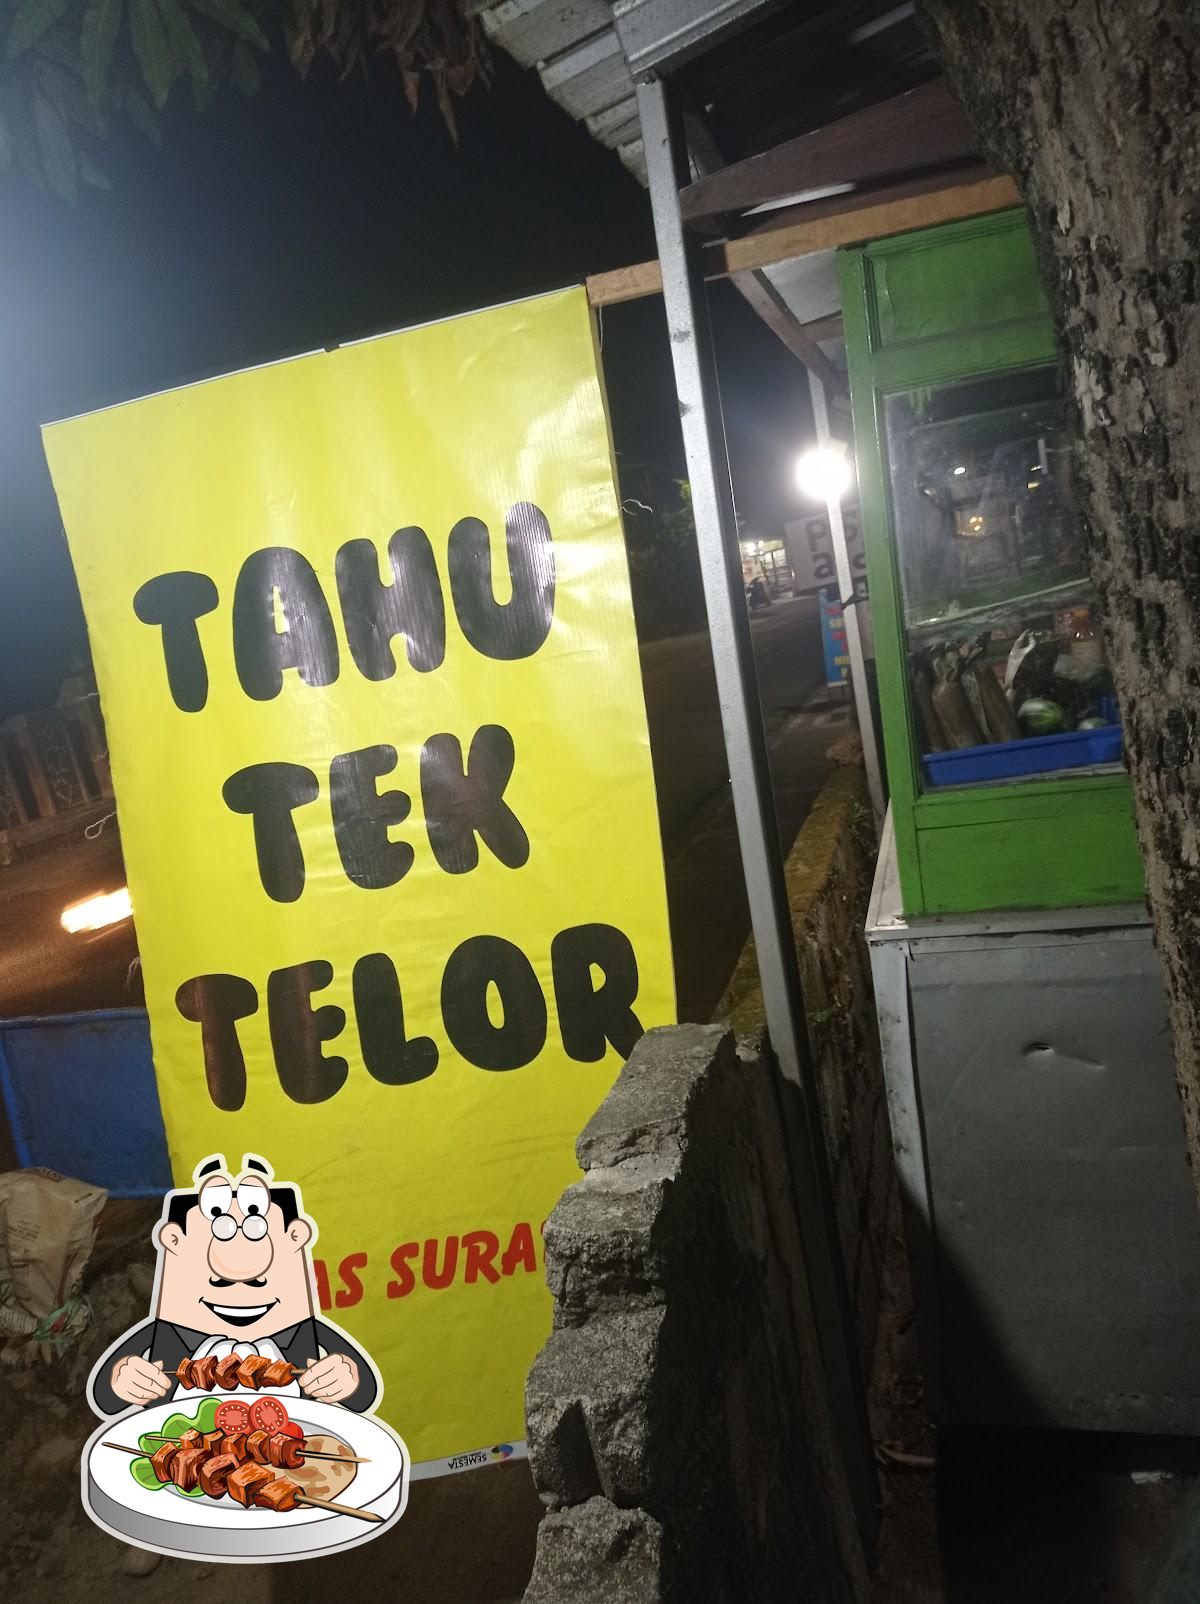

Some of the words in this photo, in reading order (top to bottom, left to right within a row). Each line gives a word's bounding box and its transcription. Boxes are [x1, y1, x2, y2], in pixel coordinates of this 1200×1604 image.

[134, 501, 556, 712] TAHU
[222, 725, 529, 902] TEK
[175, 923, 645, 1111] TELOR
[386, 1219, 547, 1299] SURA
